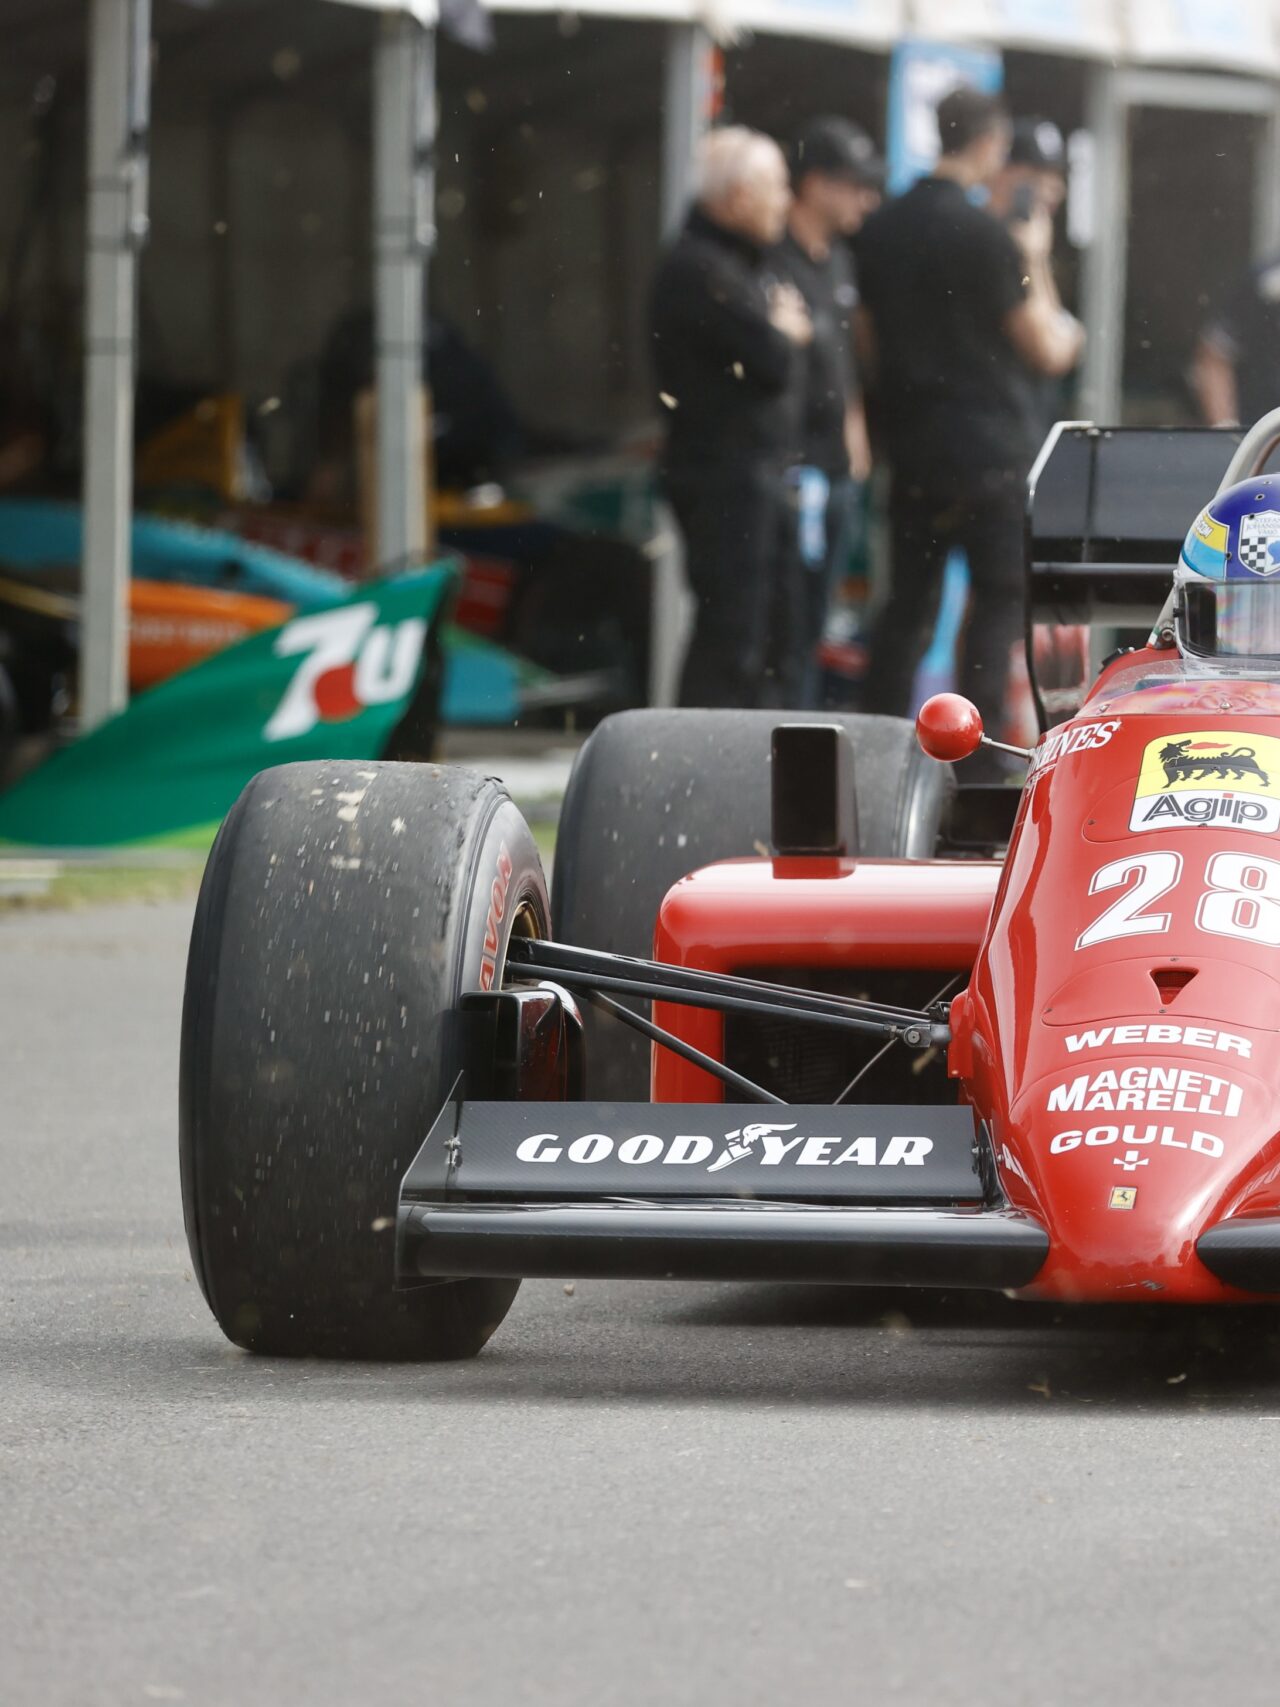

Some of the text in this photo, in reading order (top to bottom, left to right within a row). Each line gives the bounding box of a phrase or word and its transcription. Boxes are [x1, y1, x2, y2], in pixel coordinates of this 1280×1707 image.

[1142, 793, 1268, 824] Agip
[1065, 1025, 1253, 1058] WEBER
[1047, 1067, 1243, 1101] MAGNETI
[1047, 1084, 1243, 1117] MARELLI
[516, 1133, 934, 1166] GOOD YEAR
[1050, 1125, 1224, 1158] GOULD
